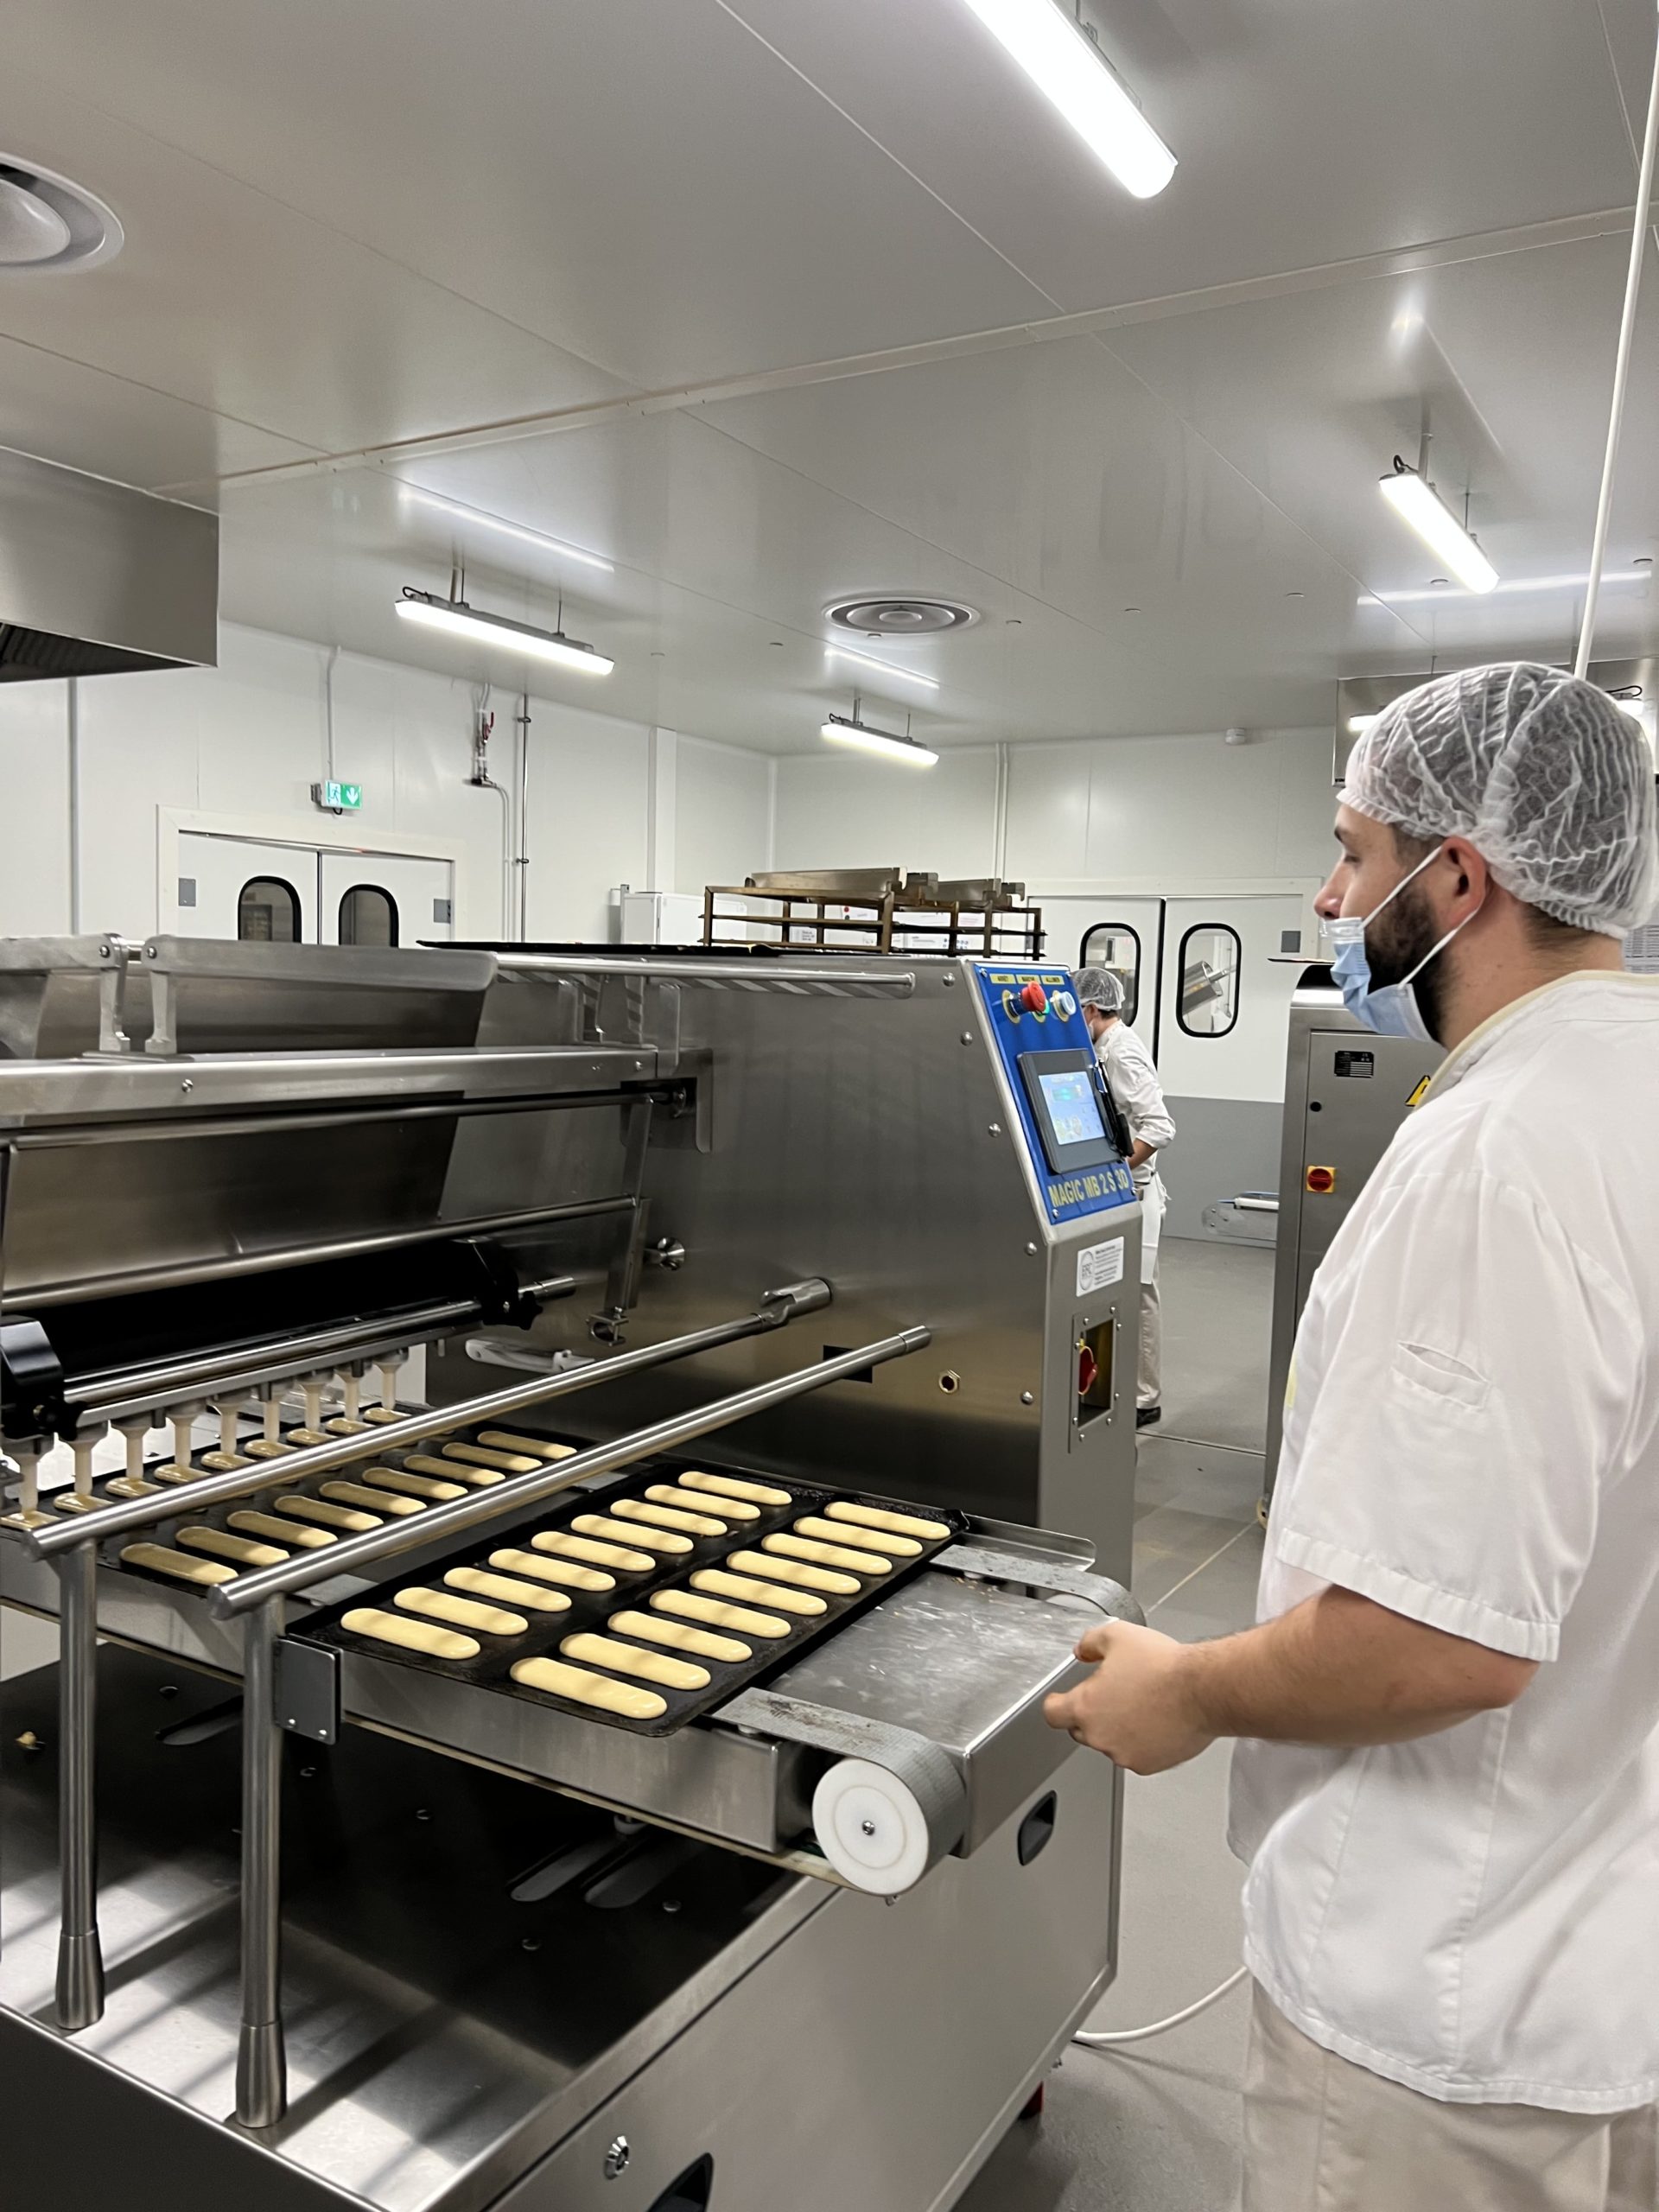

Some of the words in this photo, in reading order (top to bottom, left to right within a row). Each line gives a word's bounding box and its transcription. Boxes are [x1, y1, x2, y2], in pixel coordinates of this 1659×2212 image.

[1048, 1179, 1085, 1207] MAGIC
[1082, 1175, 1102, 1198] MB
[1099, 1173, 1109, 1194] 2
[1107, 1171, 1117, 1192] S
[1114, 1168, 1129, 1190] 3D
